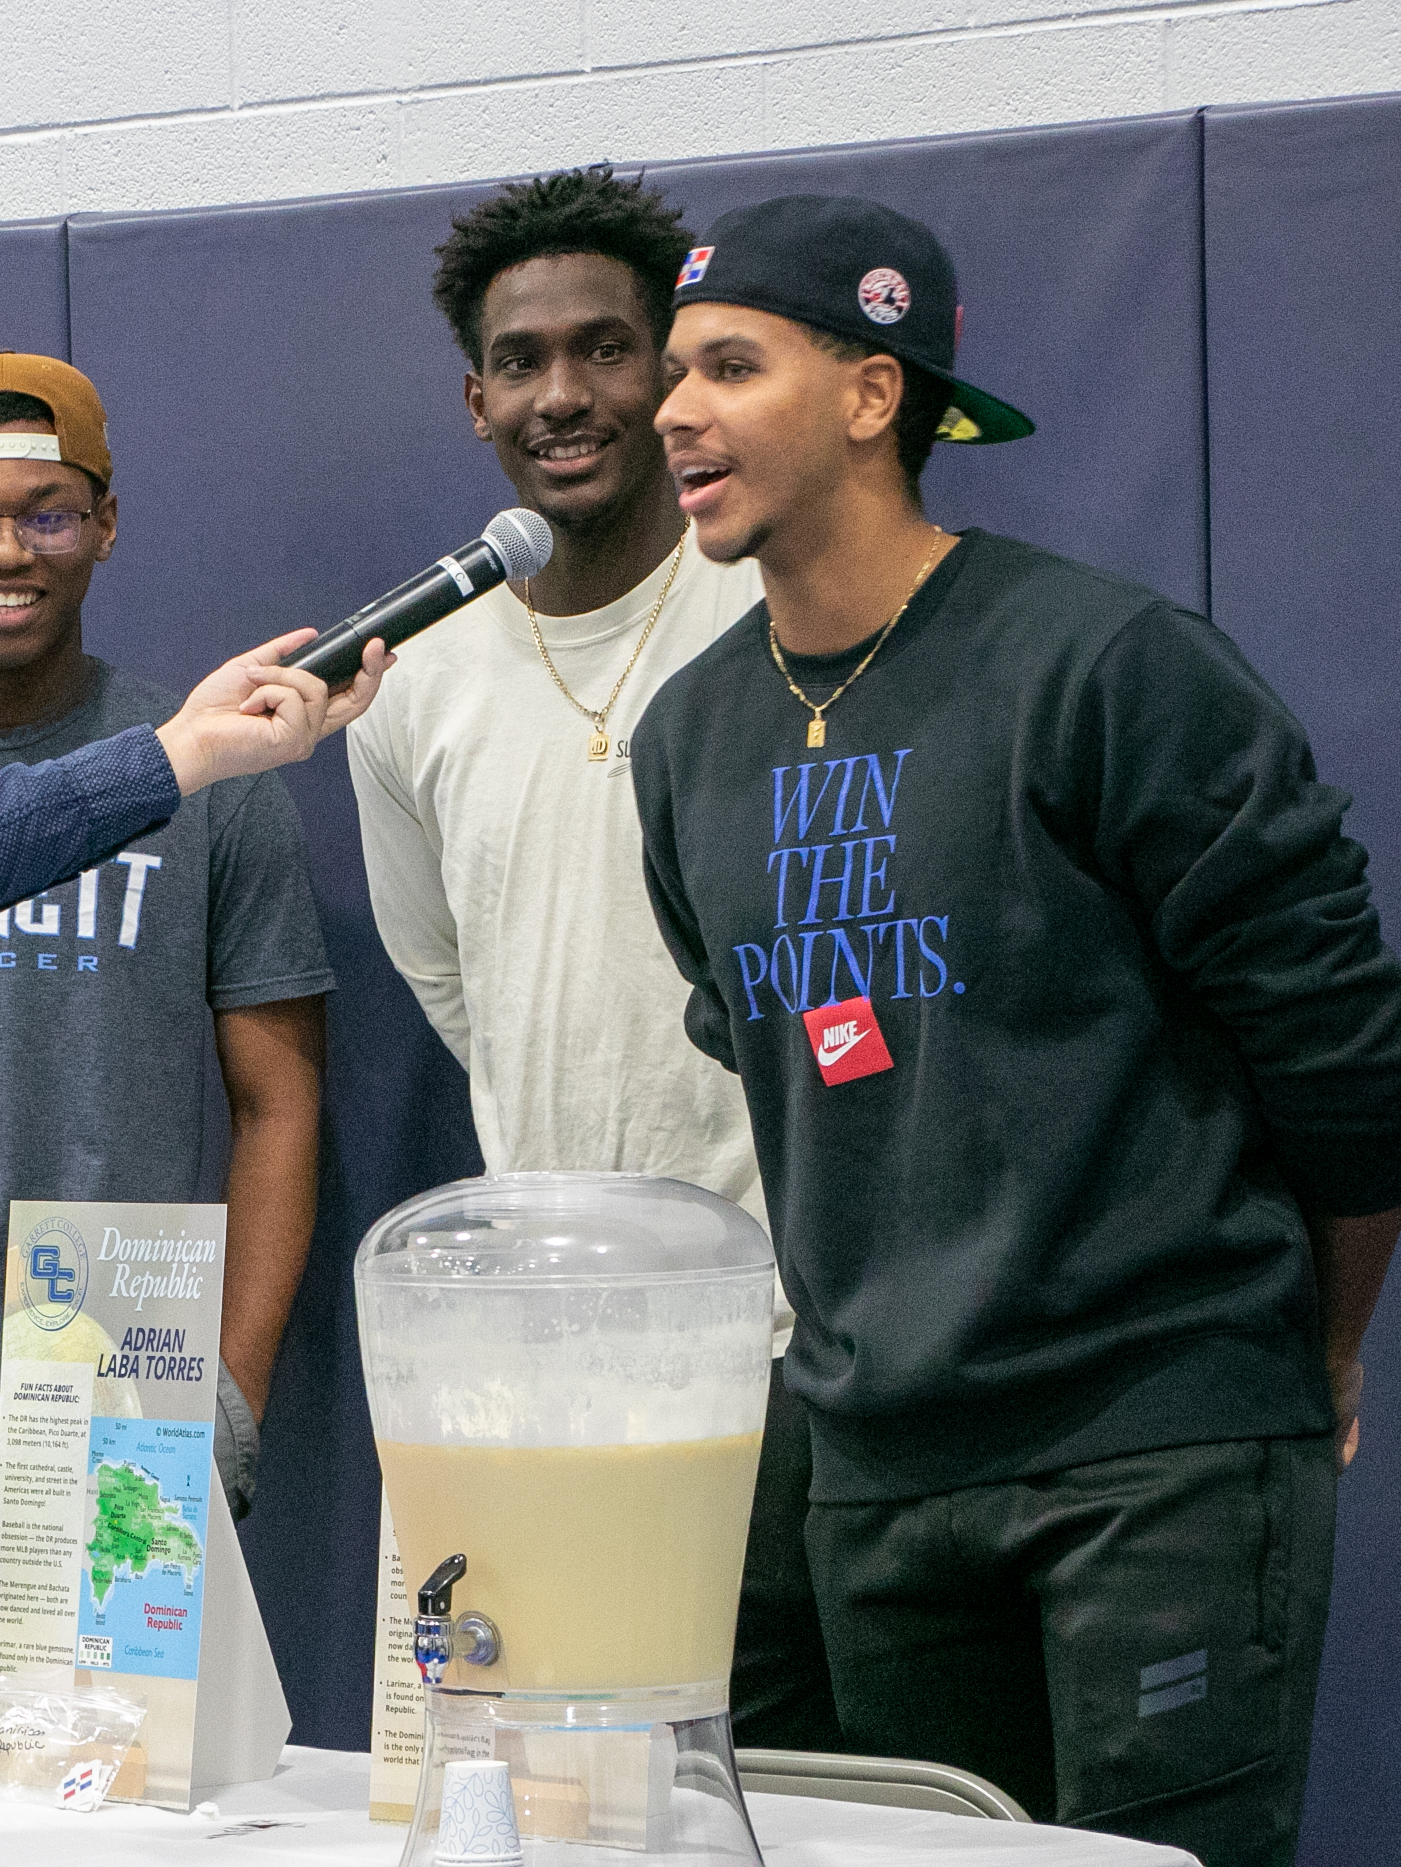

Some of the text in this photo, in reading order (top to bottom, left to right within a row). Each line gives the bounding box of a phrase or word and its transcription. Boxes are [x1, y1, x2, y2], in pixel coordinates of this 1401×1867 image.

[772, 748, 914, 845] WIN
[767, 834, 896, 929] THE
[732, 915, 966, 1021] POINTS.
[822, 1020, 858, 1048] NIKE
[96, 1226, 216, 1264] Dominican
[109, 1264, 203, 1312] Republic
[121, 1327, 186, 1354] ADRIAN
[96, 1354, 204, 1382] LABA TORRES
[14, 1392, 80, 1403] DOMINICAN REPUBLIC:
[20, 1383, 74, 1393] FUN FACTS ABOUT
[386, 1680, 416, 1692] Larimar,
[386, 1704, 418, 1716] Republic.
[384, 1730, 398, 1740] The
[383, 1756, 420, 1766] world that
